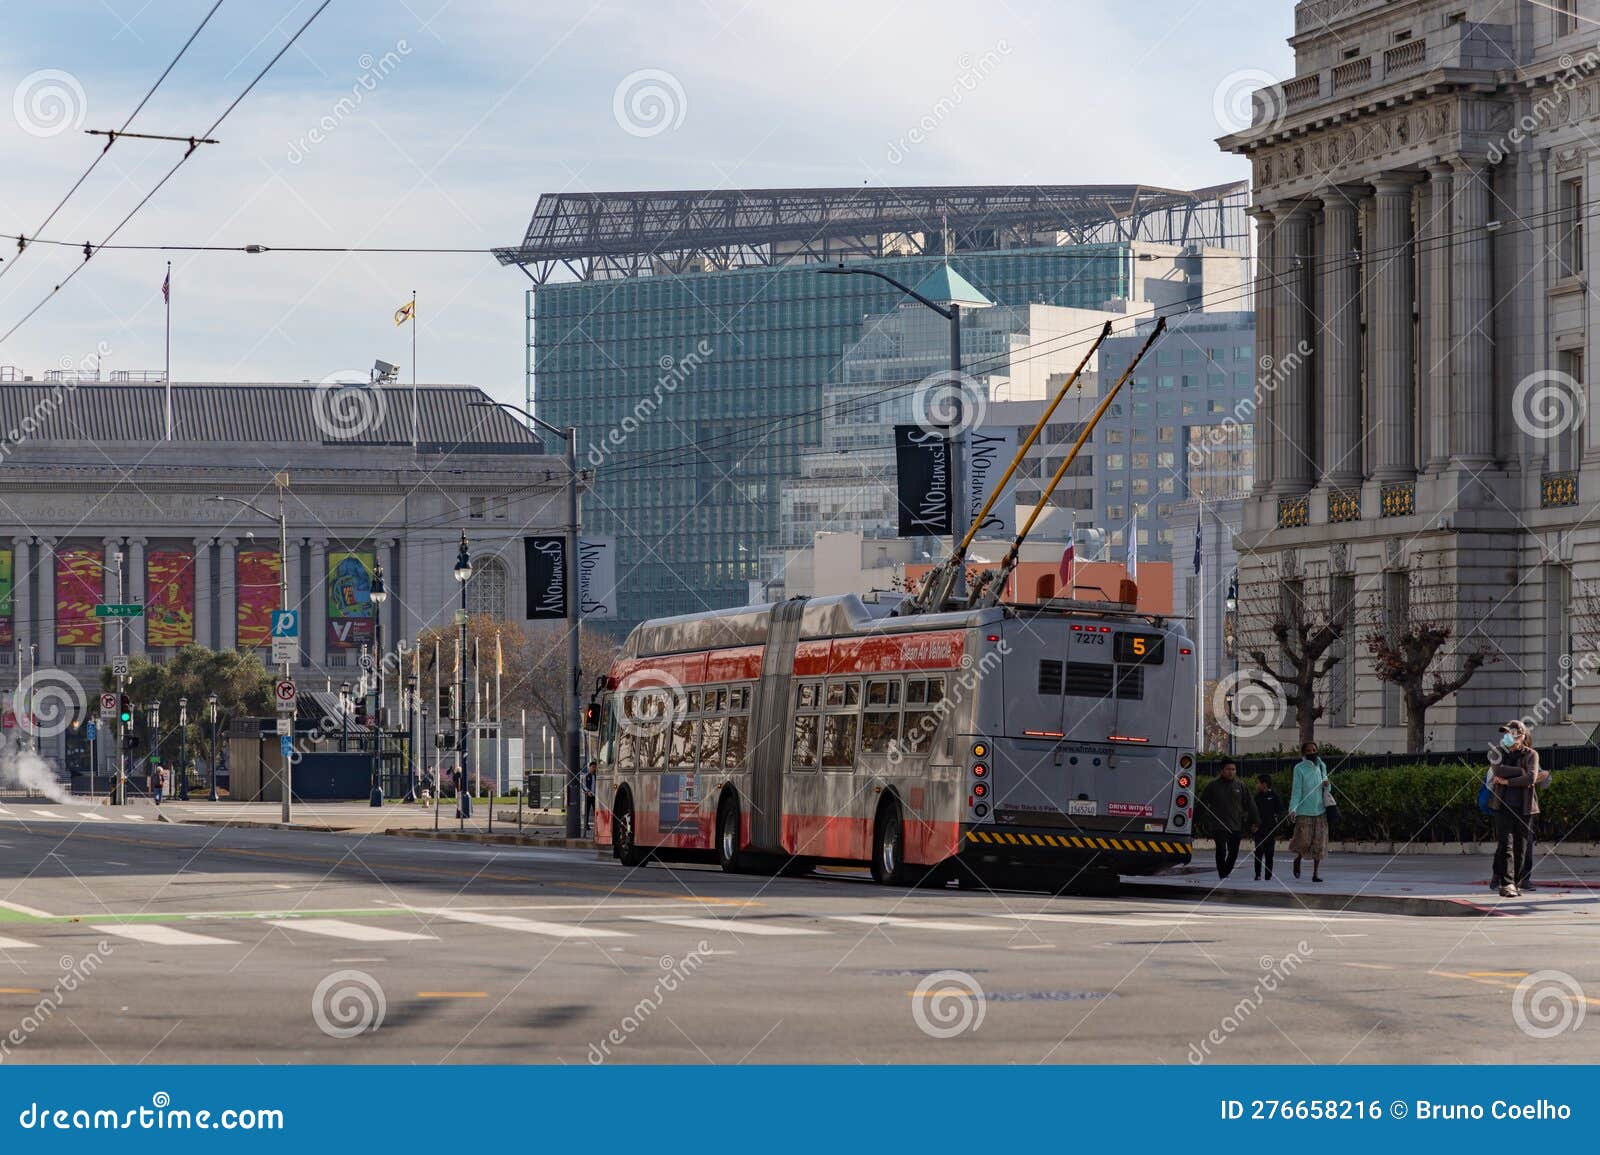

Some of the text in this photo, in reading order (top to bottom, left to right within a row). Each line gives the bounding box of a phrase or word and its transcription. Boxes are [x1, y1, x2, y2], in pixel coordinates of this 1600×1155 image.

[1075, 633, 1104, 645] 7273
[1133, 638, 1146, 655] 5
[114, 665, 127, 674] 20
